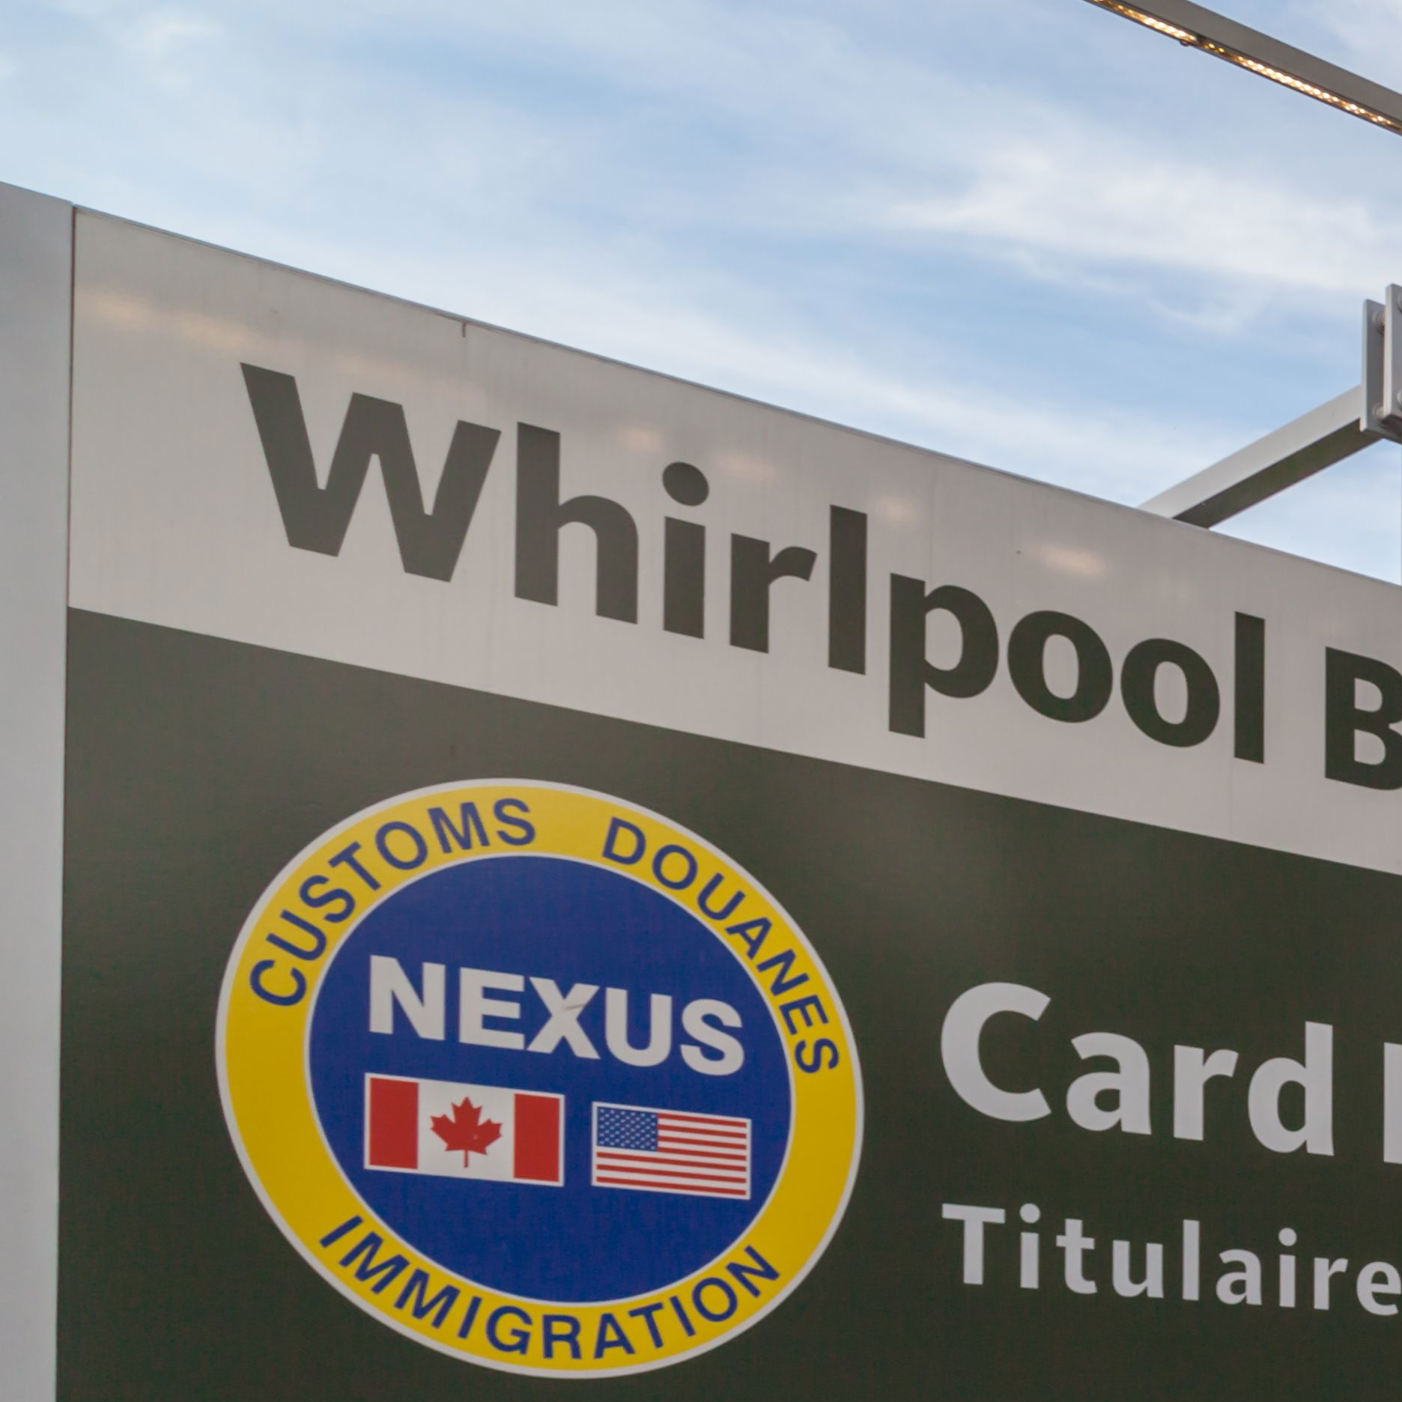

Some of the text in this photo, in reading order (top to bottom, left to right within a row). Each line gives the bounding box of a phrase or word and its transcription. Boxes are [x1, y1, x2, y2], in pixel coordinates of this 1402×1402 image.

[240, 362, 1267, 765] Whirlpool
[249, 798, 840, 1075] CUSTOMS DOUANES
[369, 954, 744, 1076] NEXUS
[941, 982, 1334, 1156] Card
[319, 1214, 781, 1361] IMMIGRATION
